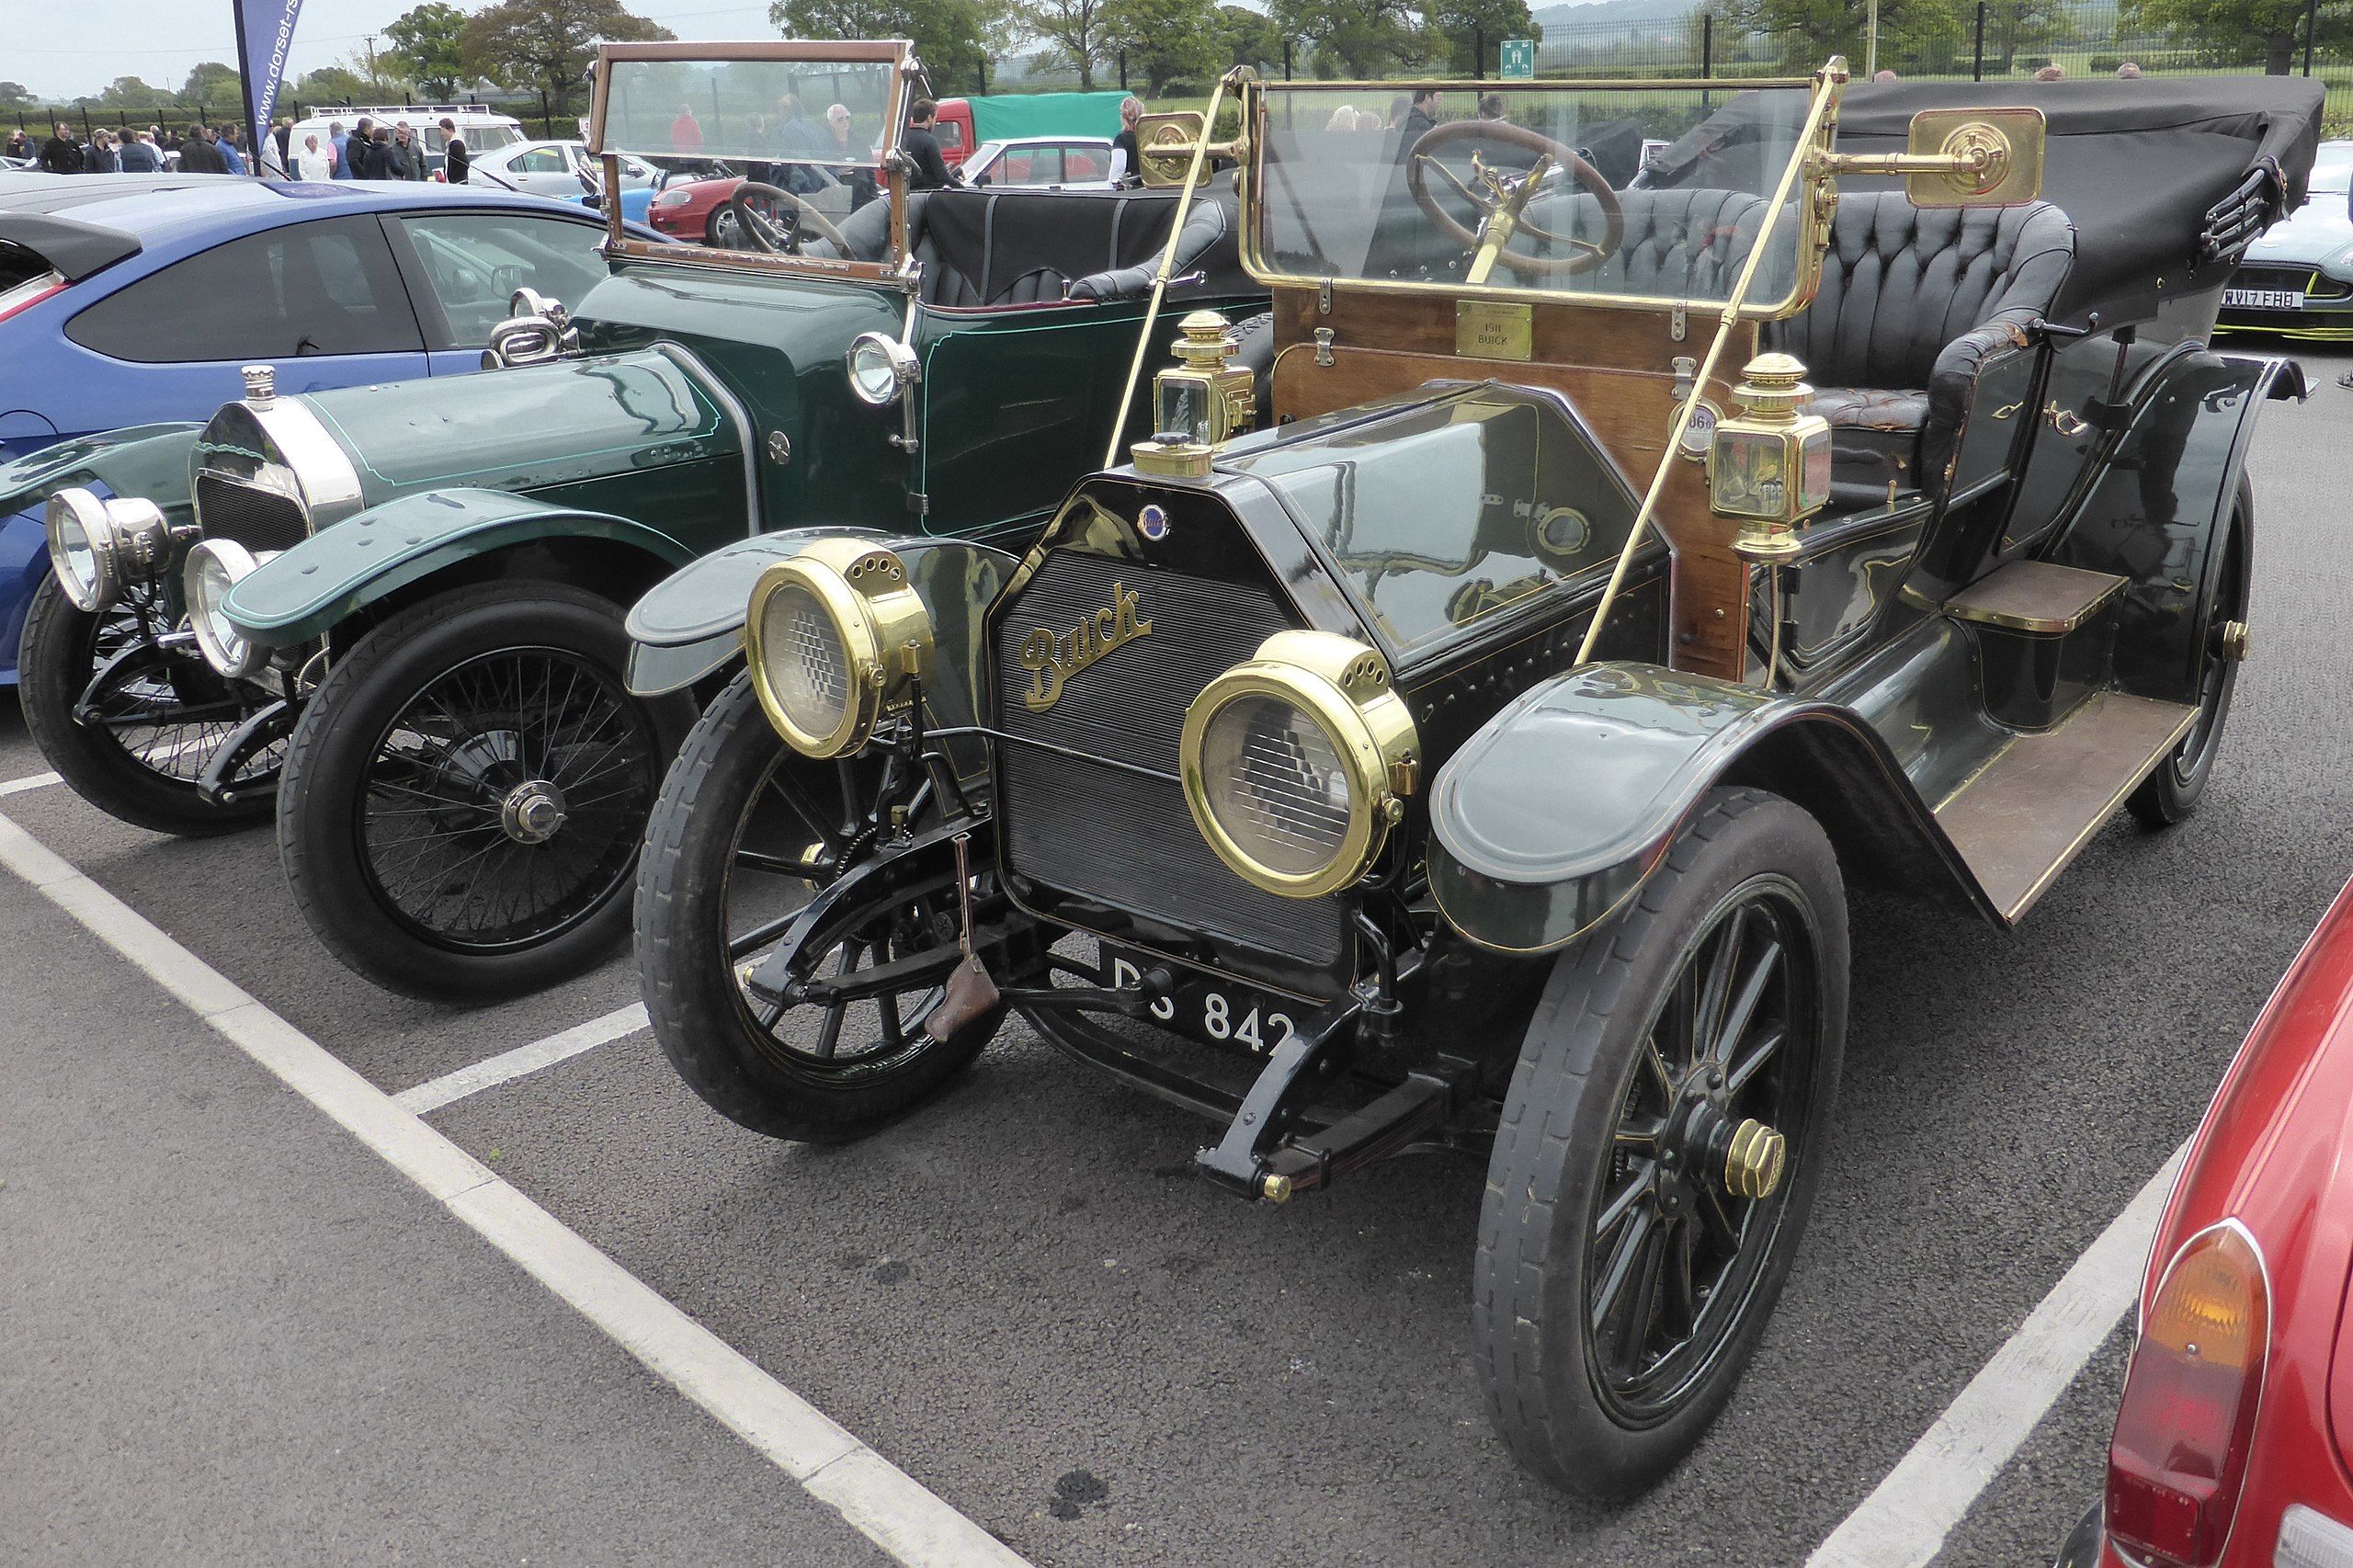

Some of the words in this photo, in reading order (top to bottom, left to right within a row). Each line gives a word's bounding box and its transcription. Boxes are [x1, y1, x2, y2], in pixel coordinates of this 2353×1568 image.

[1478, 335, 1507, 346] BUICK
[1484, 324, 1501, 333] 1911
[1020, 580, 1153, 714] Buick
[1204, 993, 1295, 1057] 842
